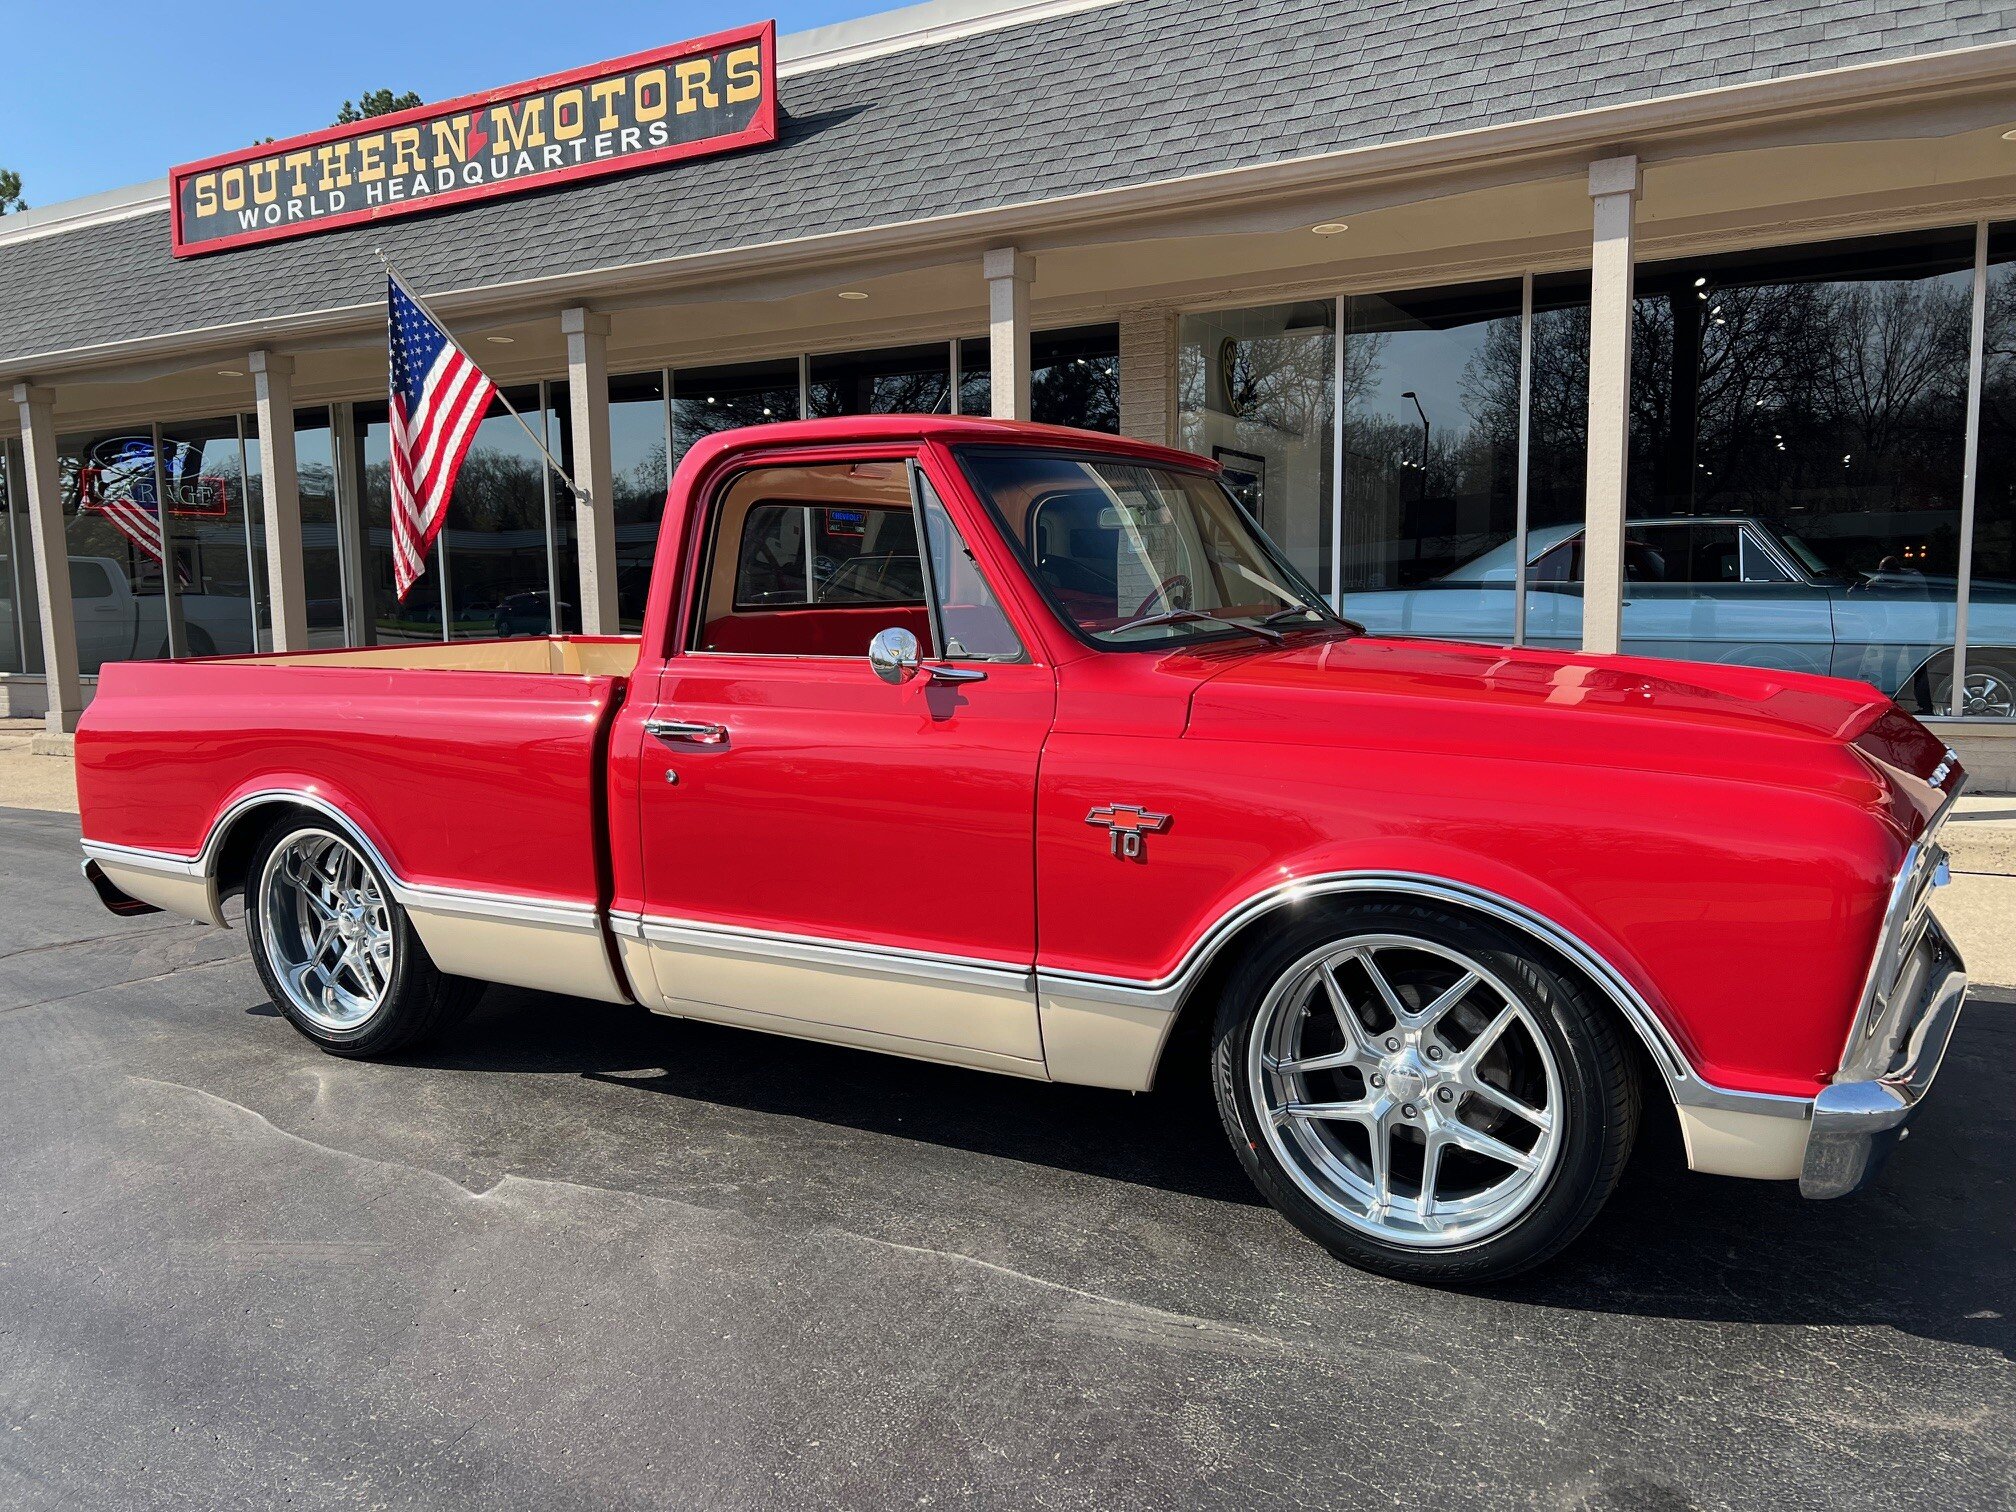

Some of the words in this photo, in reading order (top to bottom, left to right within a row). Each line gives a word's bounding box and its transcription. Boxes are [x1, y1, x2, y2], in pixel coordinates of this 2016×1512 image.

[195, 115, 470, 218] SOUTHERN
[491, 46, 761, 155] MOTORS
[238, 190, 346, 230] WORLD
[366, 121, 669, 204] HEADQUARTERS
[1109, 831, 1140, 857] 10
